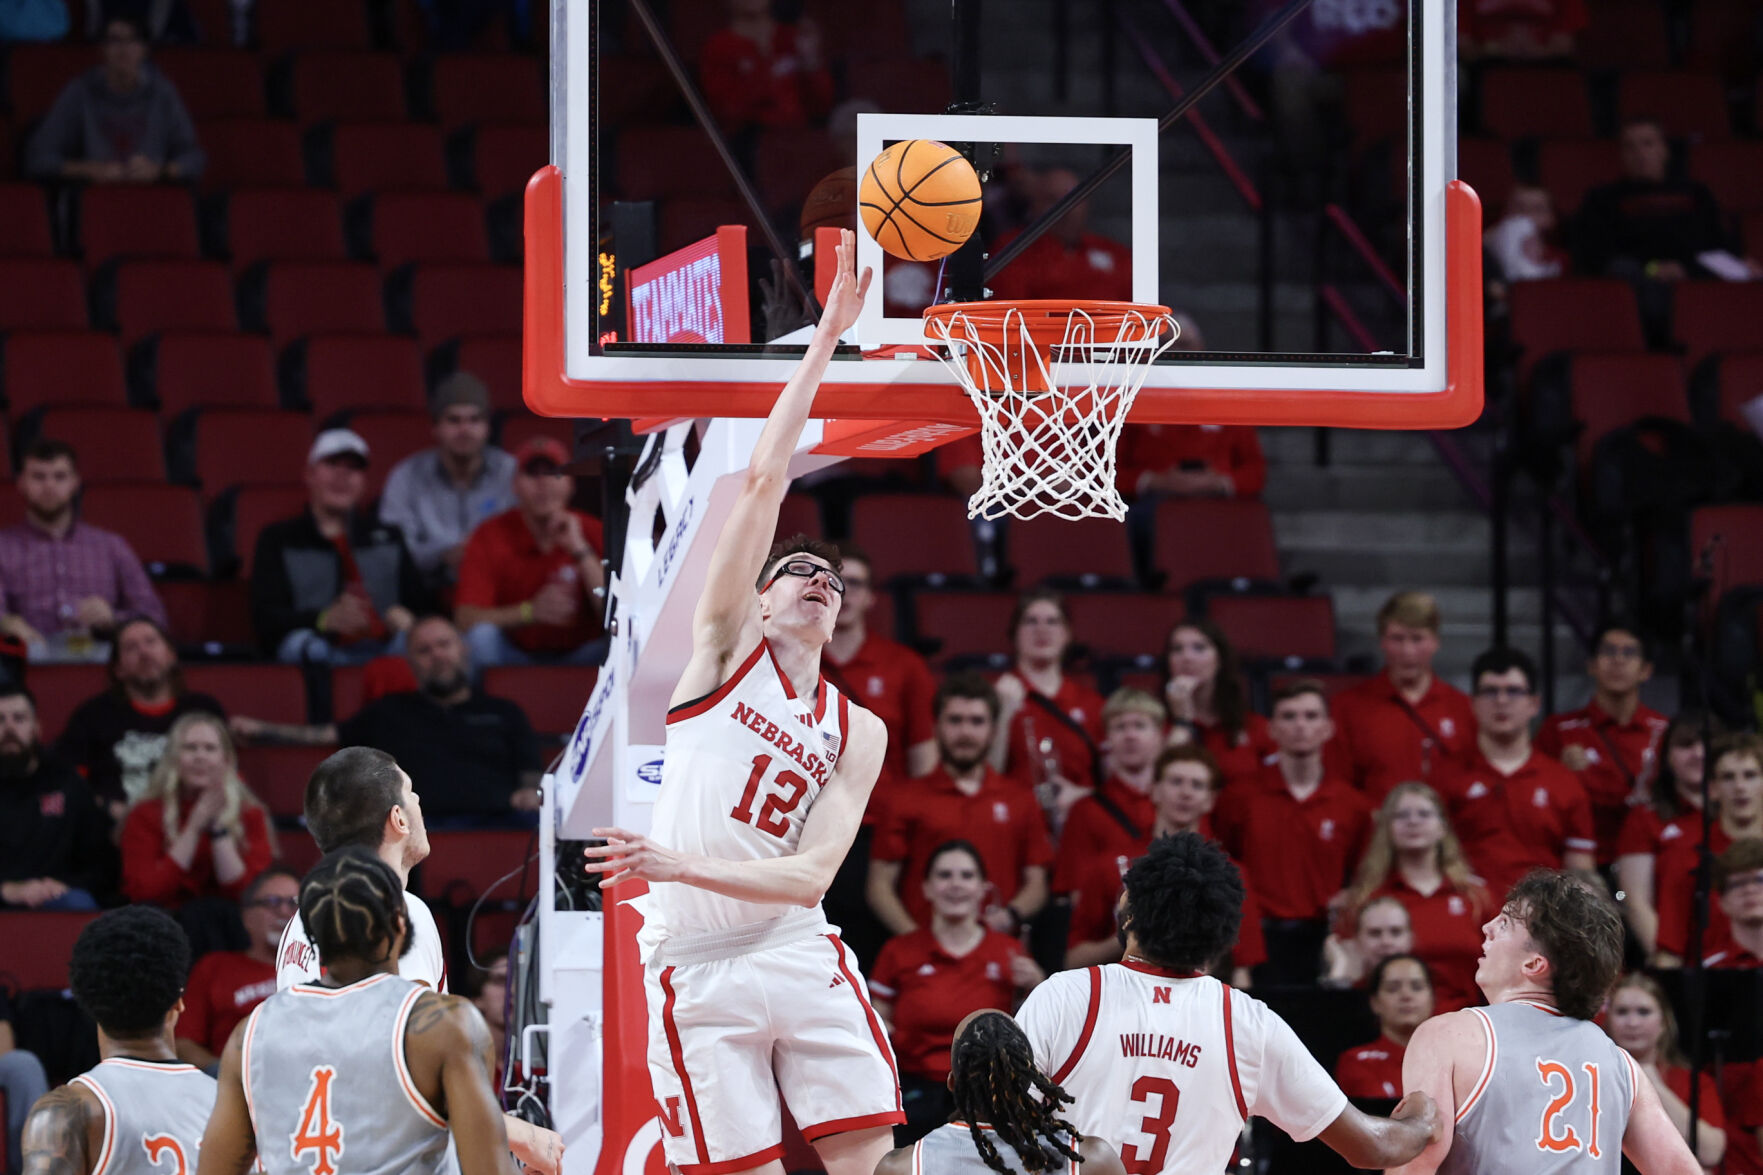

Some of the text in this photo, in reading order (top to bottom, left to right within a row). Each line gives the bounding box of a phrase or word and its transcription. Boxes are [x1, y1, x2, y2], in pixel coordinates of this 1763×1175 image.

[730, 701, 831, 789] NEBRASK
[730, 753, 808, 839] 12
[1153, 986, 1172, 1004] N
[1120, 1033, 1202, 1069] WILLIAMS
[289, 1065, 345, 1175] 4
[654, 1095, 685, 1138] N
[1120, 1075, 1180, 1175] 3
[1534, 1055, 1603, 1161] 21
